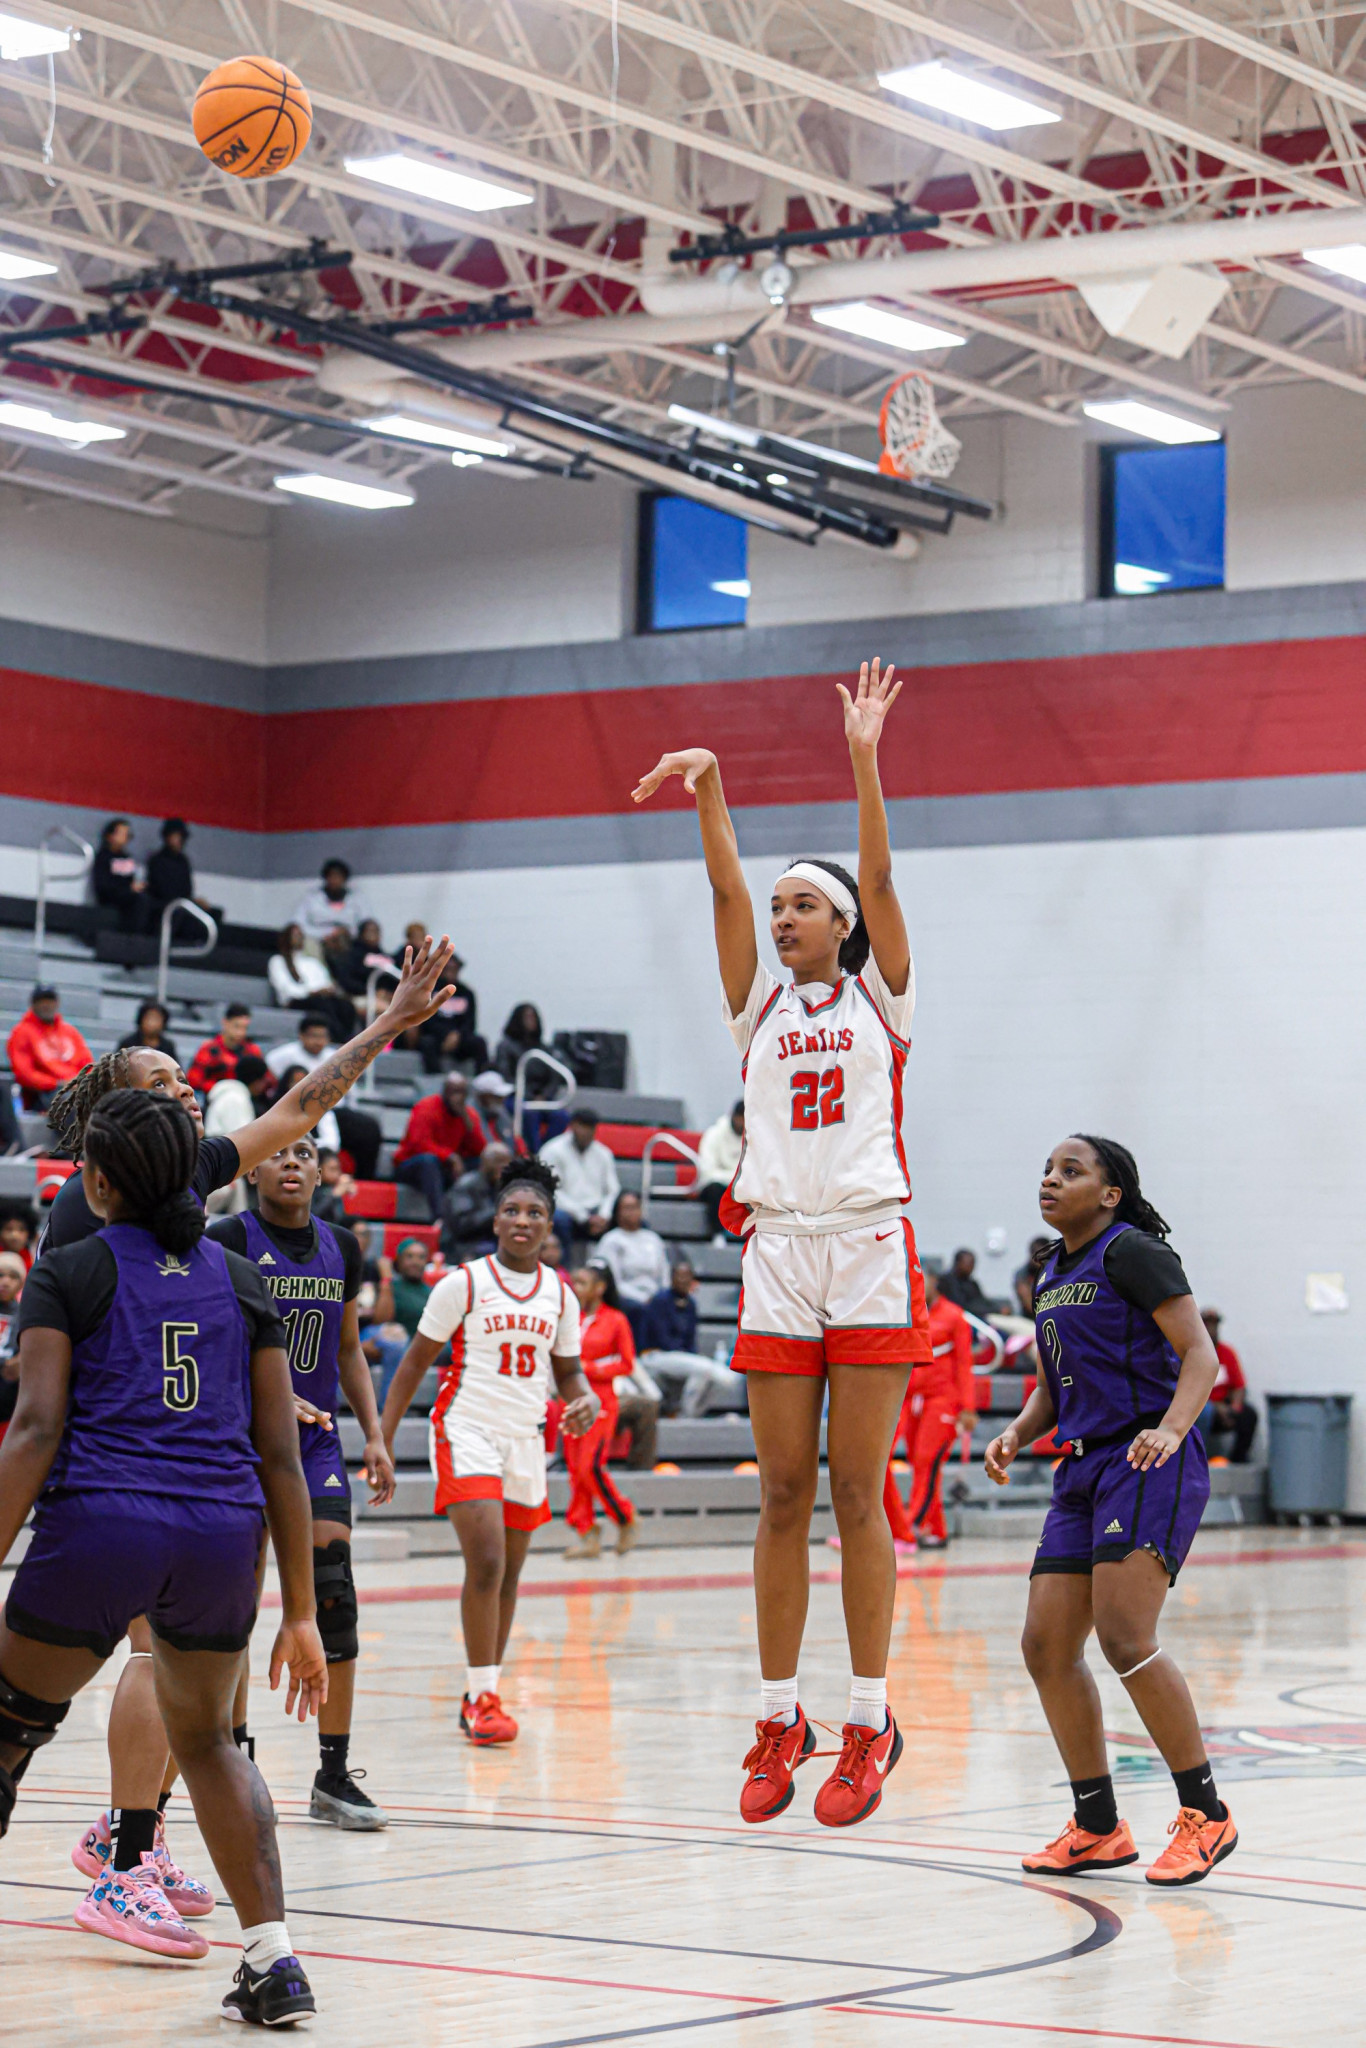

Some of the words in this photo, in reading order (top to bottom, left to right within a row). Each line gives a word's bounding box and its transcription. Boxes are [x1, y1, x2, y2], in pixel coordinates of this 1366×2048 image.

[790, 1065, 846, 1131] 22
[262, 1276, 345, 1303] ICHMOND
[1034, 1282, 1099, 1316] CHMOND
[283, 1308, 324, 1374] 10
[484, 1313, 553, 1340] JENKINS
[162, 1321, 199, 1412] 5
[498, 1342, 537, 1378] 10
[1042, 1318, 1073, 1388] 2
